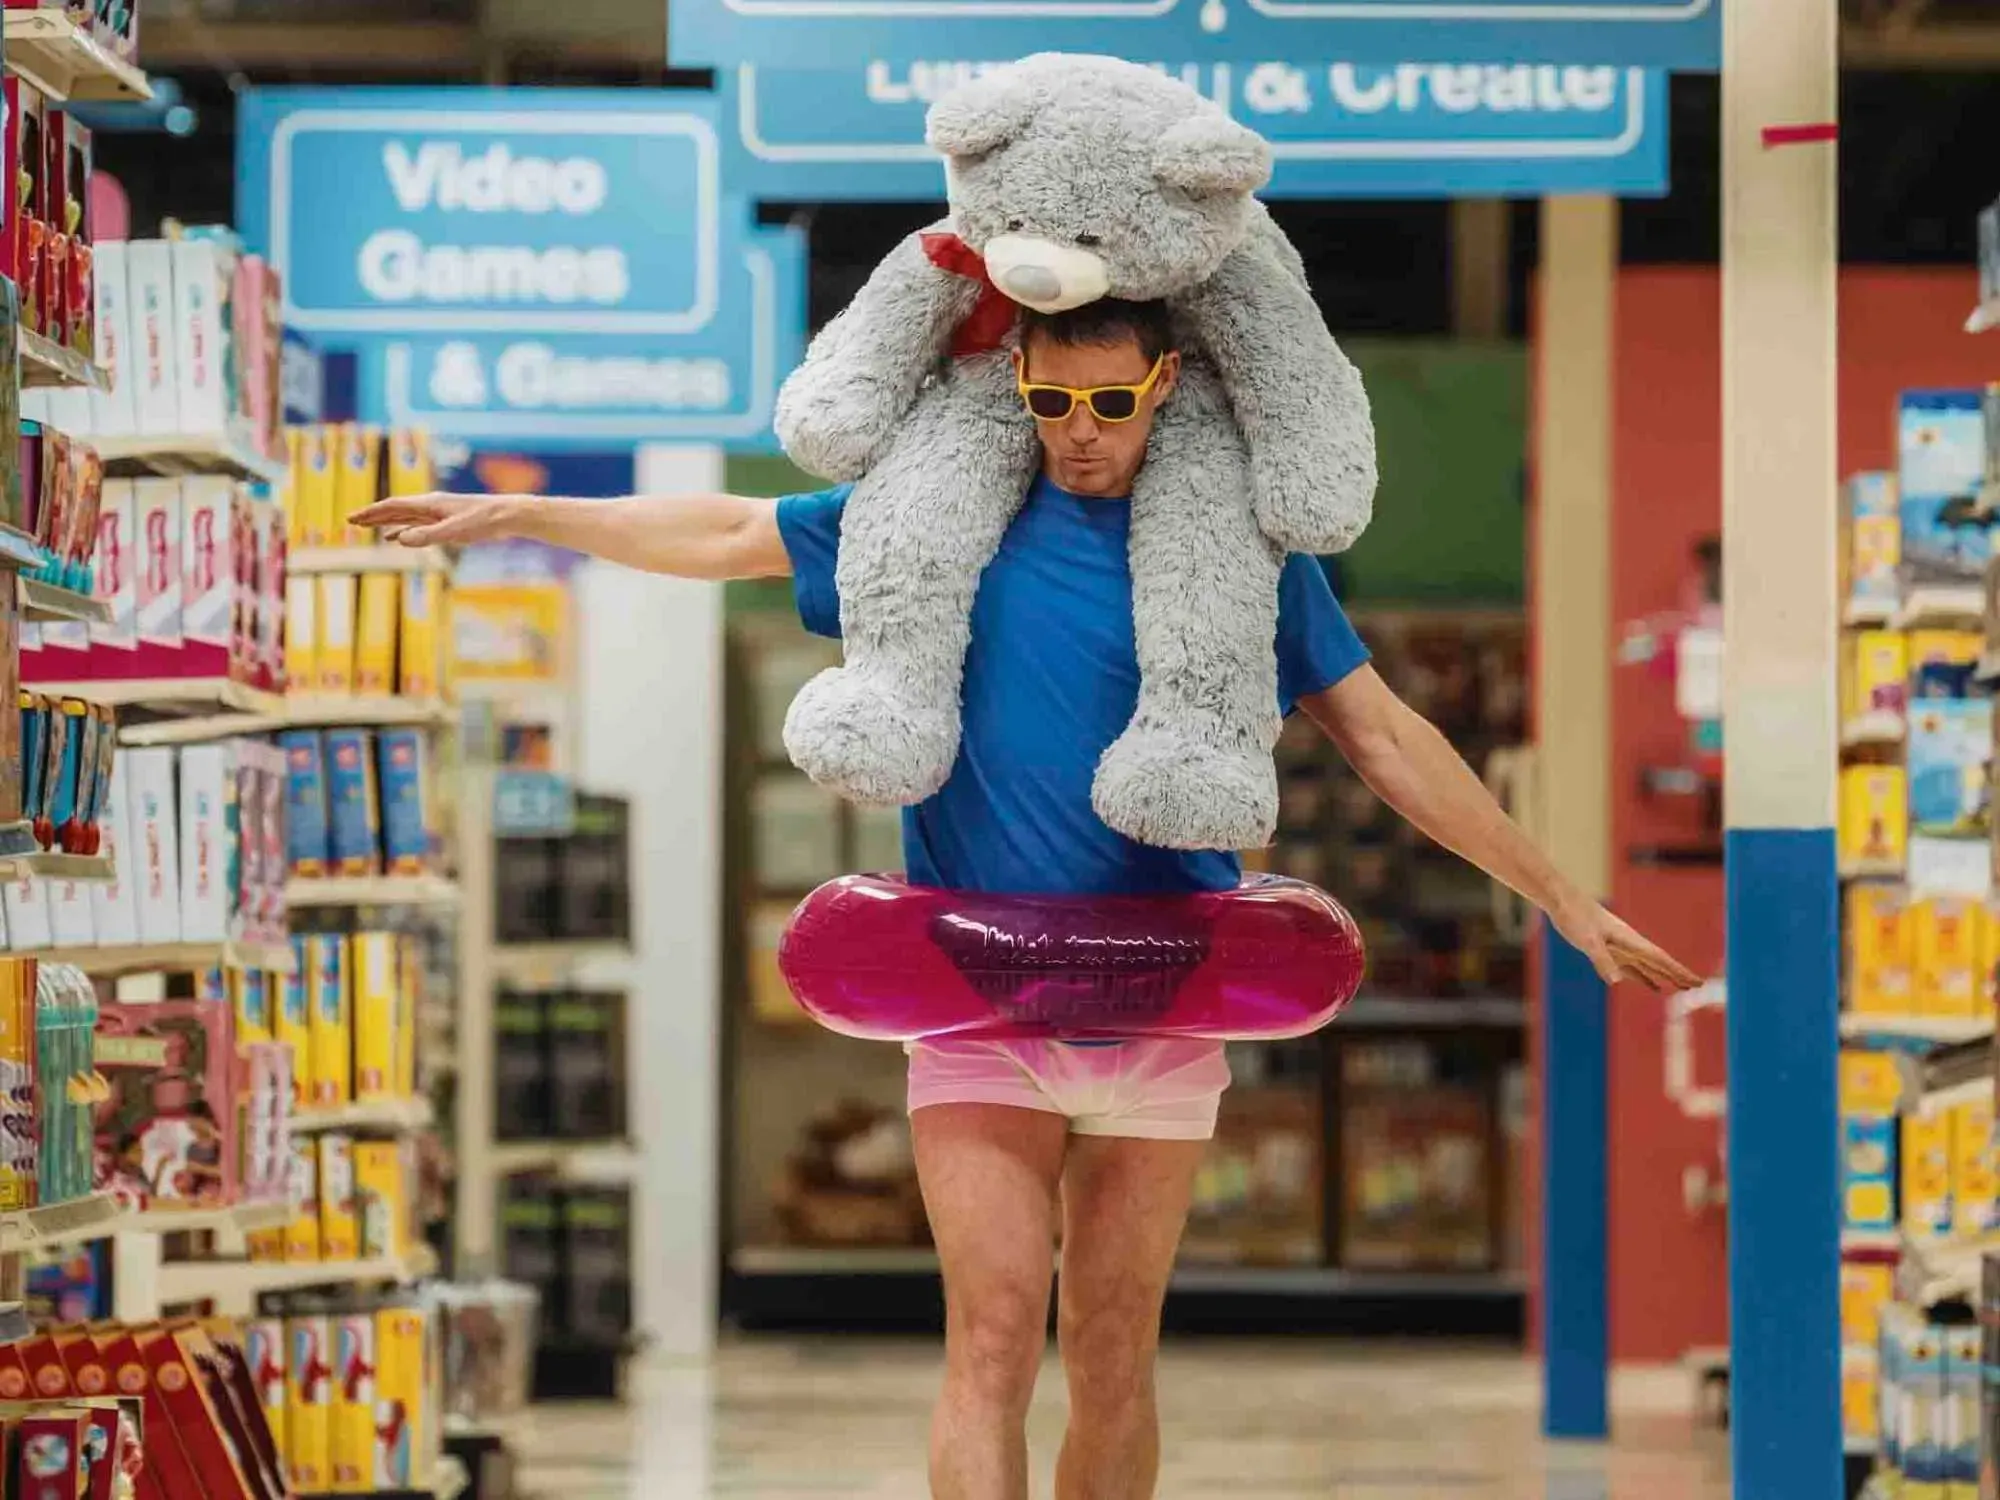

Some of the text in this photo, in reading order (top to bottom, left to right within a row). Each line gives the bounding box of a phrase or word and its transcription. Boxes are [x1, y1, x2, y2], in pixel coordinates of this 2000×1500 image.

[1245, 63, 1616, 113] & Create
[383, 141, 606, 213] Video
[358, 229, 629, 304] Games
[430, 341, 730, 408] & Games
